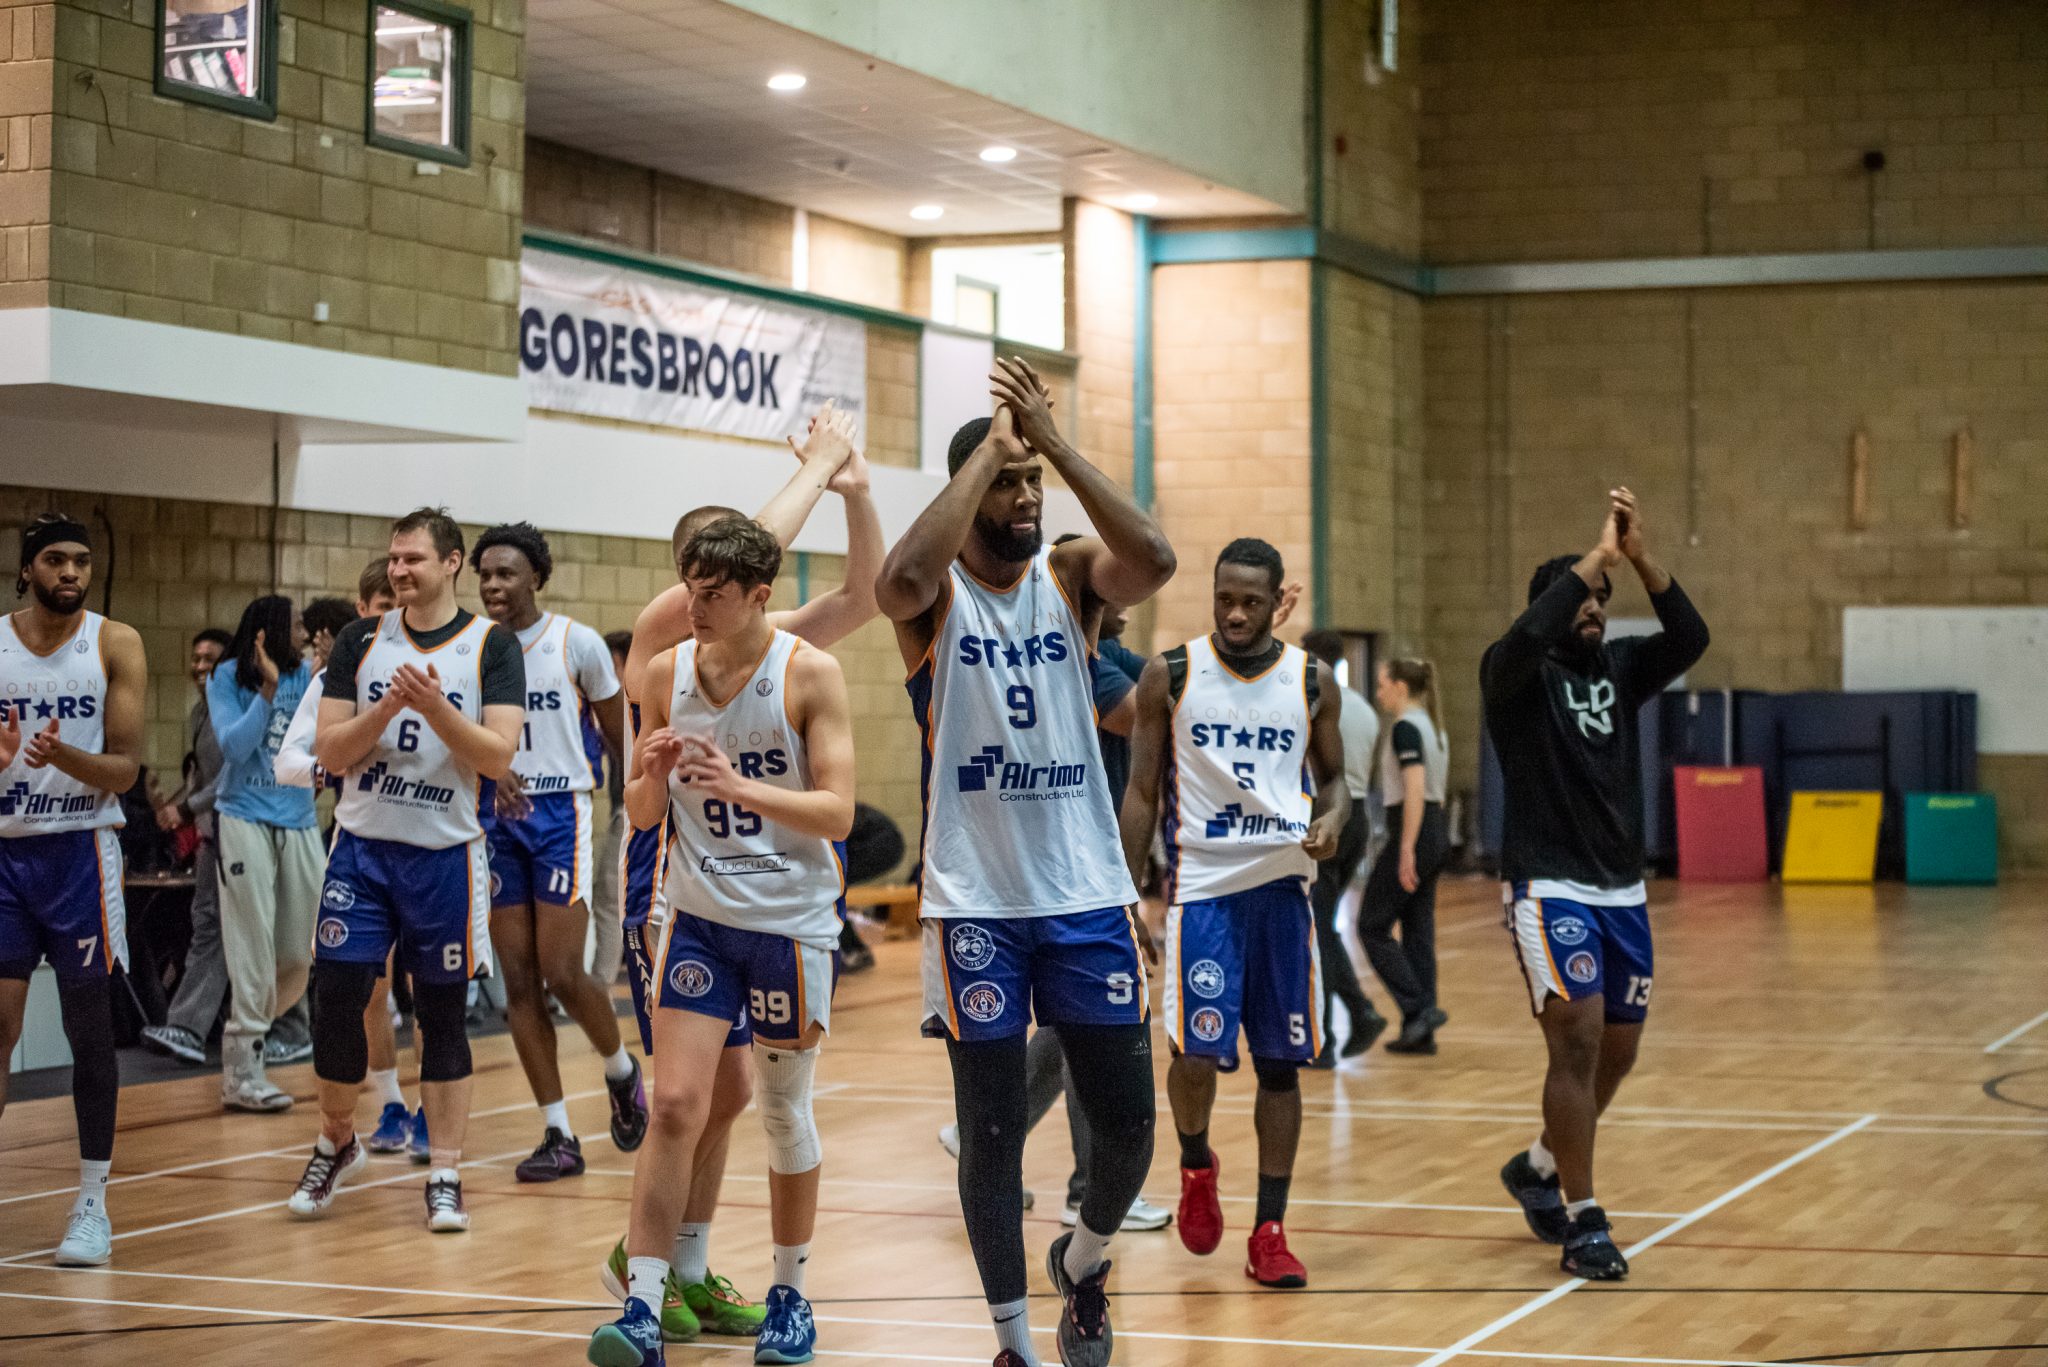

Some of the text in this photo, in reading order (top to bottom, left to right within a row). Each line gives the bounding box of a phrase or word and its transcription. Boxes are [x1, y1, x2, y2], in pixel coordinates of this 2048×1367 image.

[521, 307, 781, 410] GORESBROOK
[6, 679, 98, 695] ONDON
[1007, 684, 1037, 729] 9
[397, 719, 421, 753] 6
[1232, 762, 1256, 792] 5
[377, 796, 433, 811] Construction
[1000, 791, 1070, 802] Construction
[23, 813, 84, 824] Construction
[77, 935, 98, 967] 7
[443, 943, 463, 971] 6
[1107, 973, 1134, 1004] 9
[1624, 975, 1653, 1006] 13
[750, 987, 791, 1024] 99
[1289, 1014, 1306, 1046] 5
